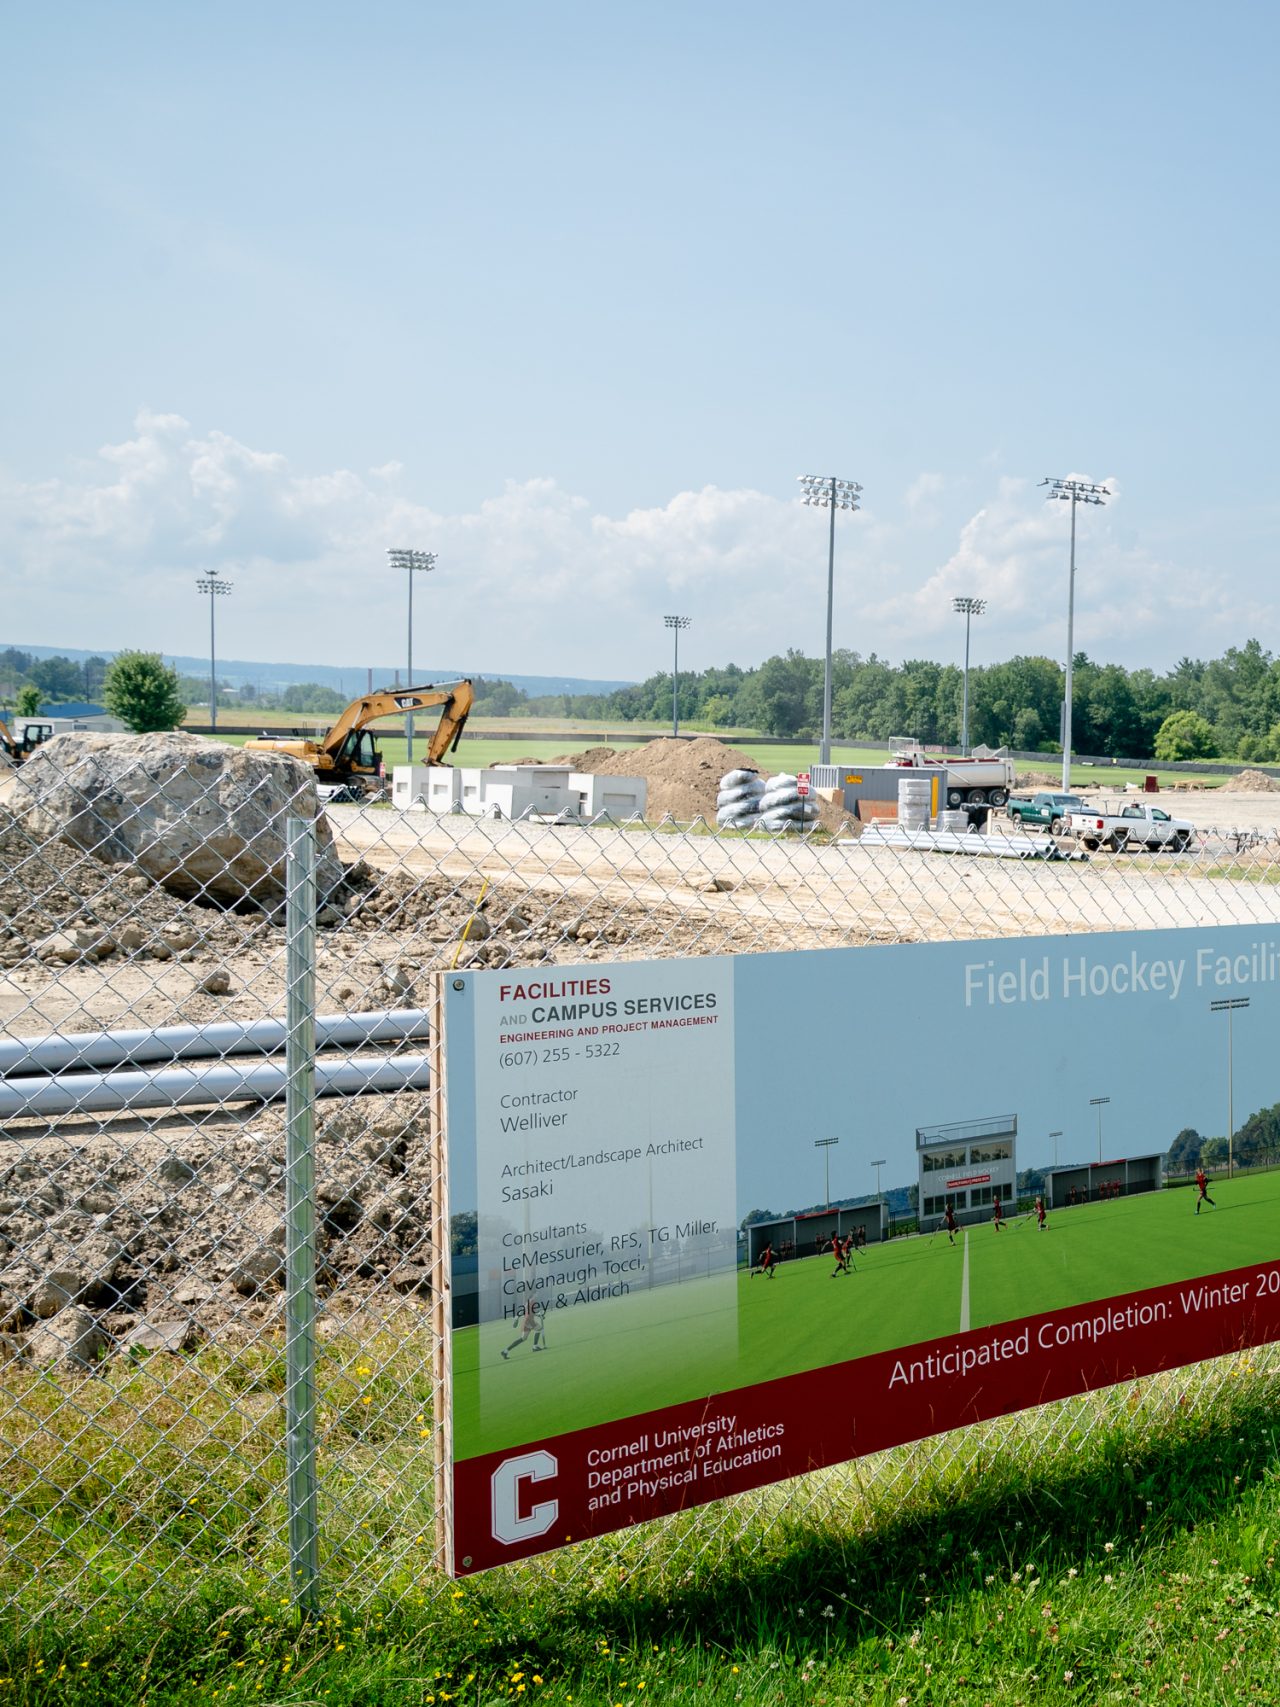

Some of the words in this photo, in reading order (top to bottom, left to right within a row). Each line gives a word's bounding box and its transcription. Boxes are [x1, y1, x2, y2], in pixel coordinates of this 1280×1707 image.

[401, 698, 414, 708] CAT
[500, 978, 611, 1001] FACILITIES
[965, 956, 1049, 1007] Field
[1063, 950, 1186, 1001] Hockey
[500, 1014, 527, 1026] AND
[532, 1001, 618, 1023] CAMPUS
[624, 993, 717, 1015] SERVICES
[500, 1028, 574, 1043] ENGINEERING
[577, 1026, 599, 1036] AND
[602, 1021, 648, 1034] PROJECT
[651, 1015, 719, 1029] MANAGEMENT
[499, 1050, 538, 1069] (607)
[543, 1047, 570, 1062] 255
[585, 1042, 620, 1058] 5322
[501, 1088, 578, 1109] Contractor
[500, 1112, 568, 1133] Welliver
[501, 1146, 642, 1178] Architect/Landscape
[646, 1137, 704, 1157] Architect
[502, 1179, 554, 1202] Sasaki
[502, 1222, 587, 1247] Consultants
[503, 1241, 604, 1271] LeMessurier,
[611, 1232, 643, 1251] RFS,
[648, 1226, 670, 1244] TG
[676, 1219, 719, 1239] Miller,
[503, 1263, 597, 1295] Cavanaugh
[603, 1254, 645, 1276] Tocci,
[503, 1297, 550, 1319] Haley
[555, 1293, 568, 1308] &
[573, 1281, 630, 1304] Aldrich
[888, 1328, 1028, 1389] Anticipated
[1038, 1298, 1173, 1349] Completion:
[1180, 1281, 1250, 1315] Winter
[587, 1435, 648, 1467] Cornell
[654, 1415, 736, 1448] University
[588, 1446, 690, 1489] Department
[695, 1439, 712, 1458] of
[716, 1423, 785, 1453] Athletics
[588, 1486, 621, 1511] and
[627, 1464, 698, 1500] Physical
[703, 1444, 782, 1478] Education
[491, 1449, 559, 1545] C
